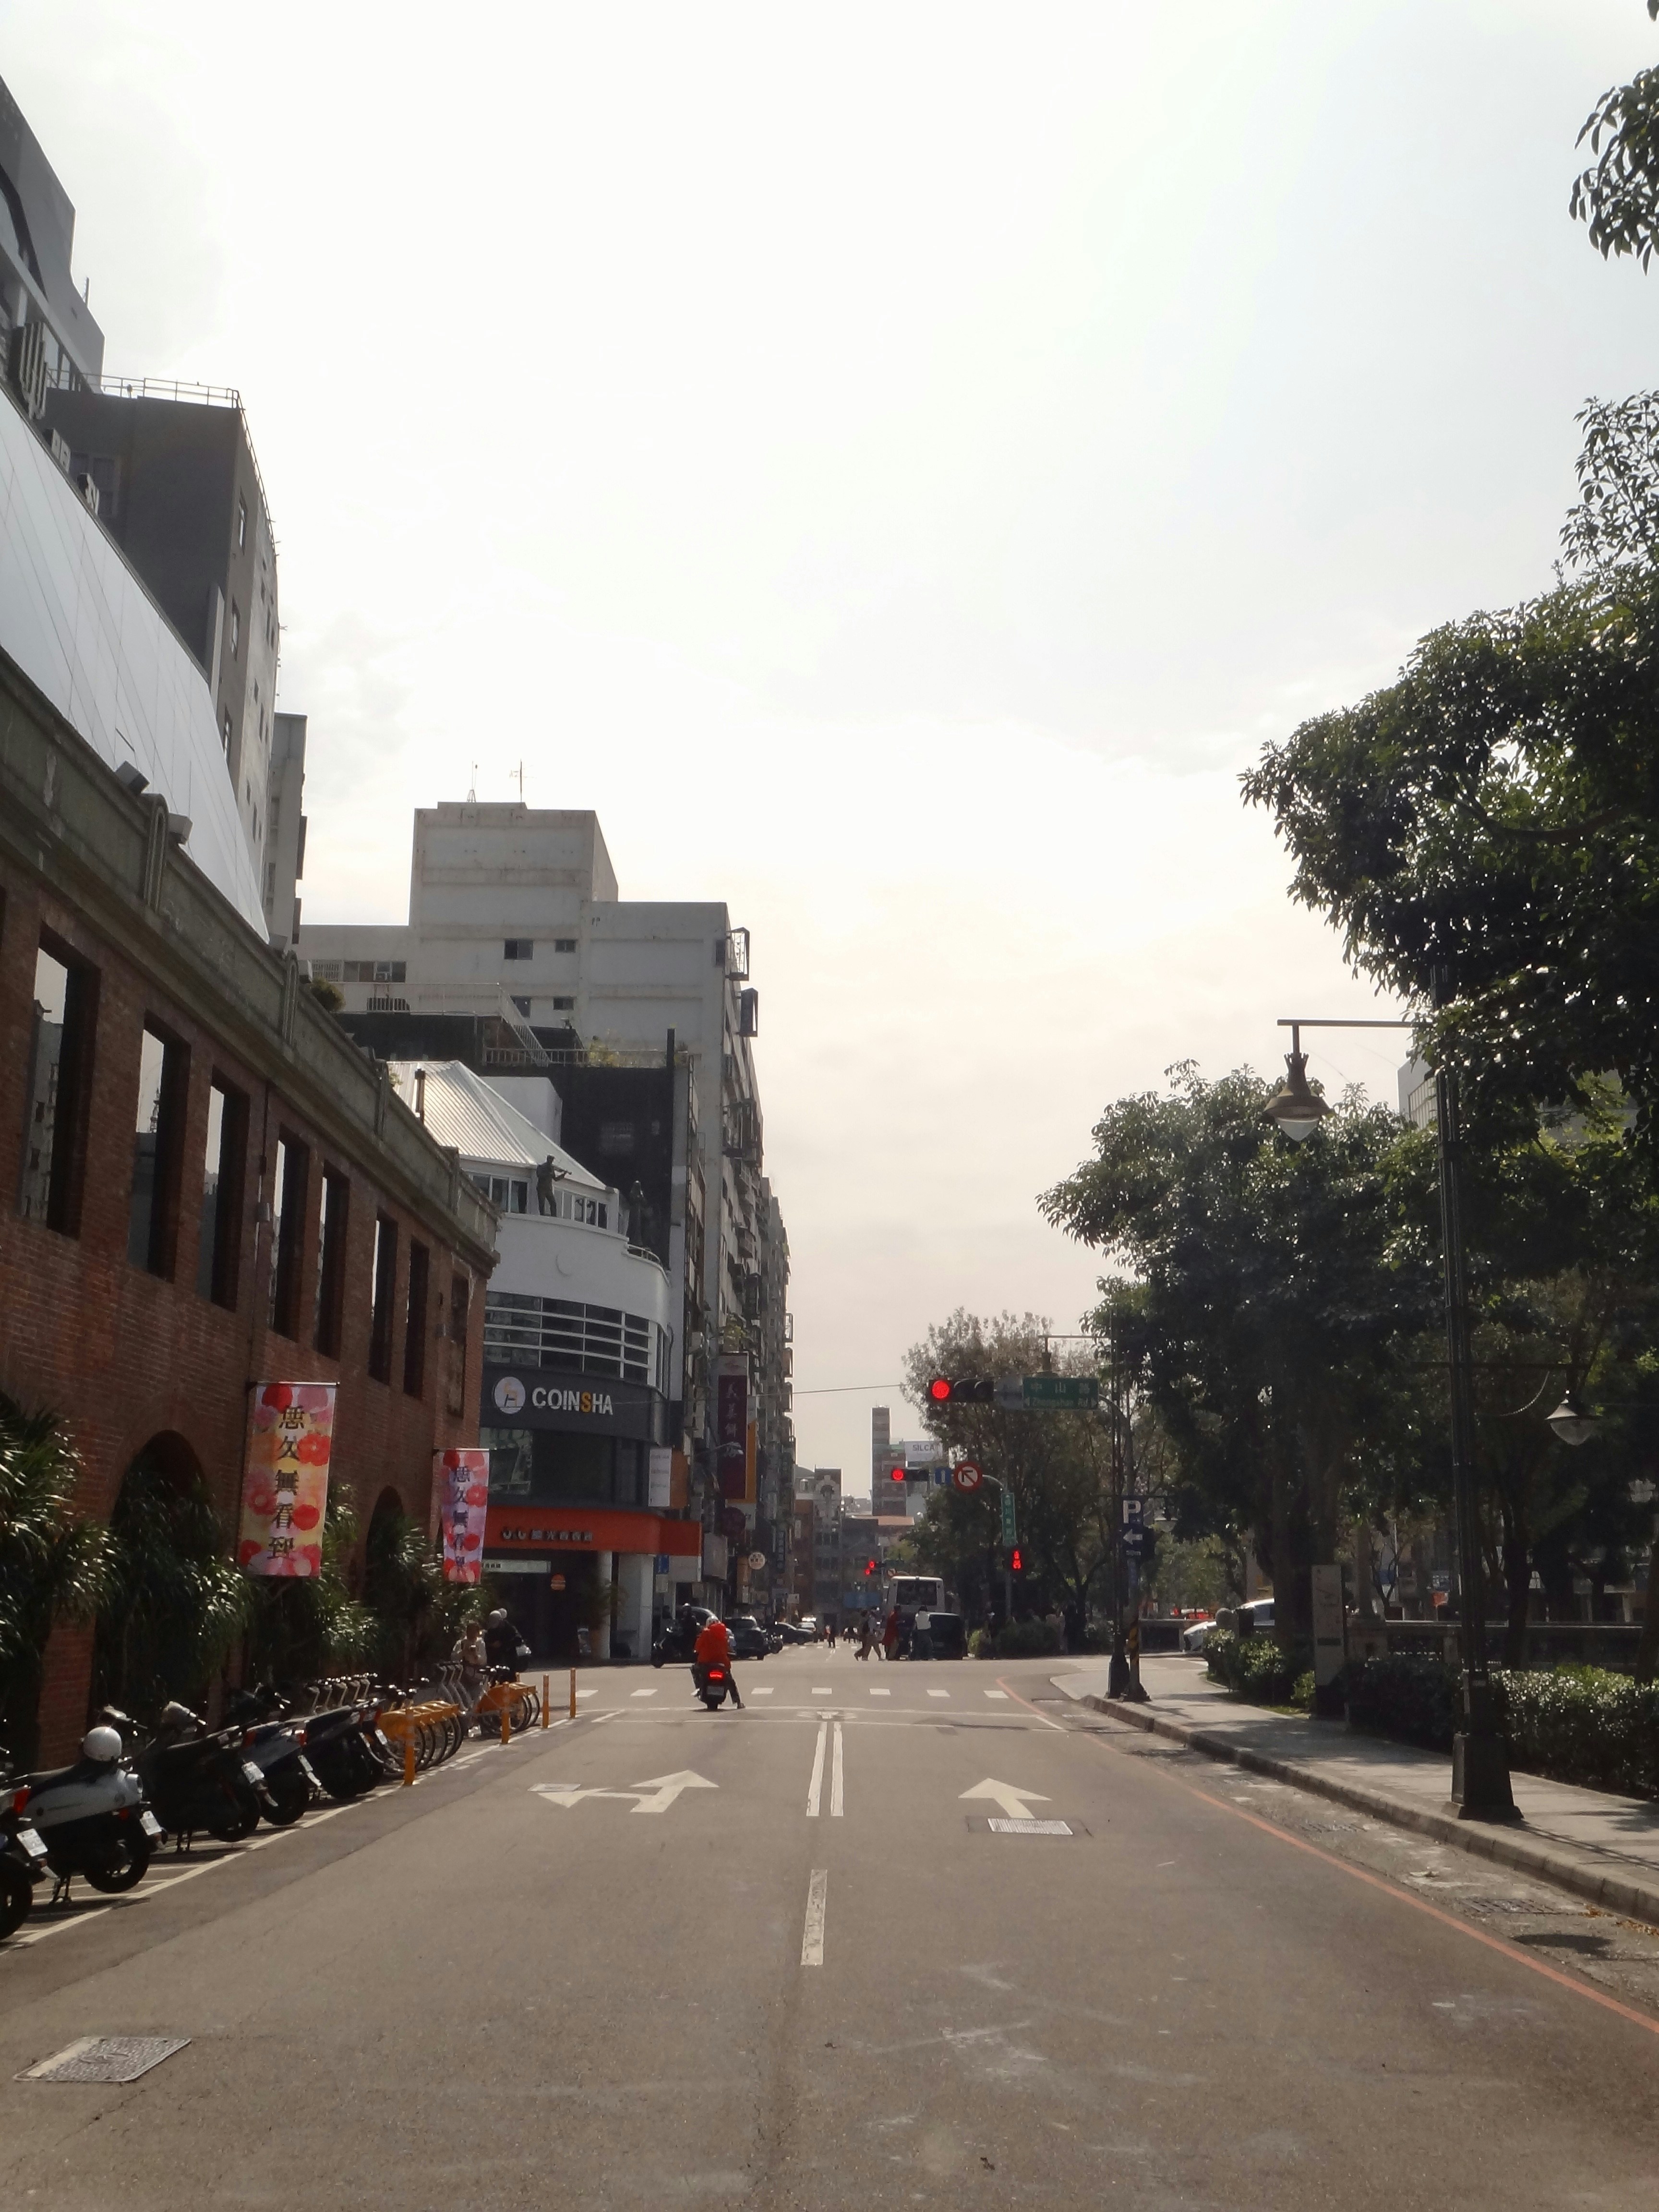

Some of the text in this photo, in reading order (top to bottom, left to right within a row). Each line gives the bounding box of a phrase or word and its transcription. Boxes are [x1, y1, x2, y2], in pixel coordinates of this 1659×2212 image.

[1031, 1382, 1090, 1394] 中山路
[532, 1387, 613, 1415] COINSHA
[1123, 1500, 1141, 1524] P
